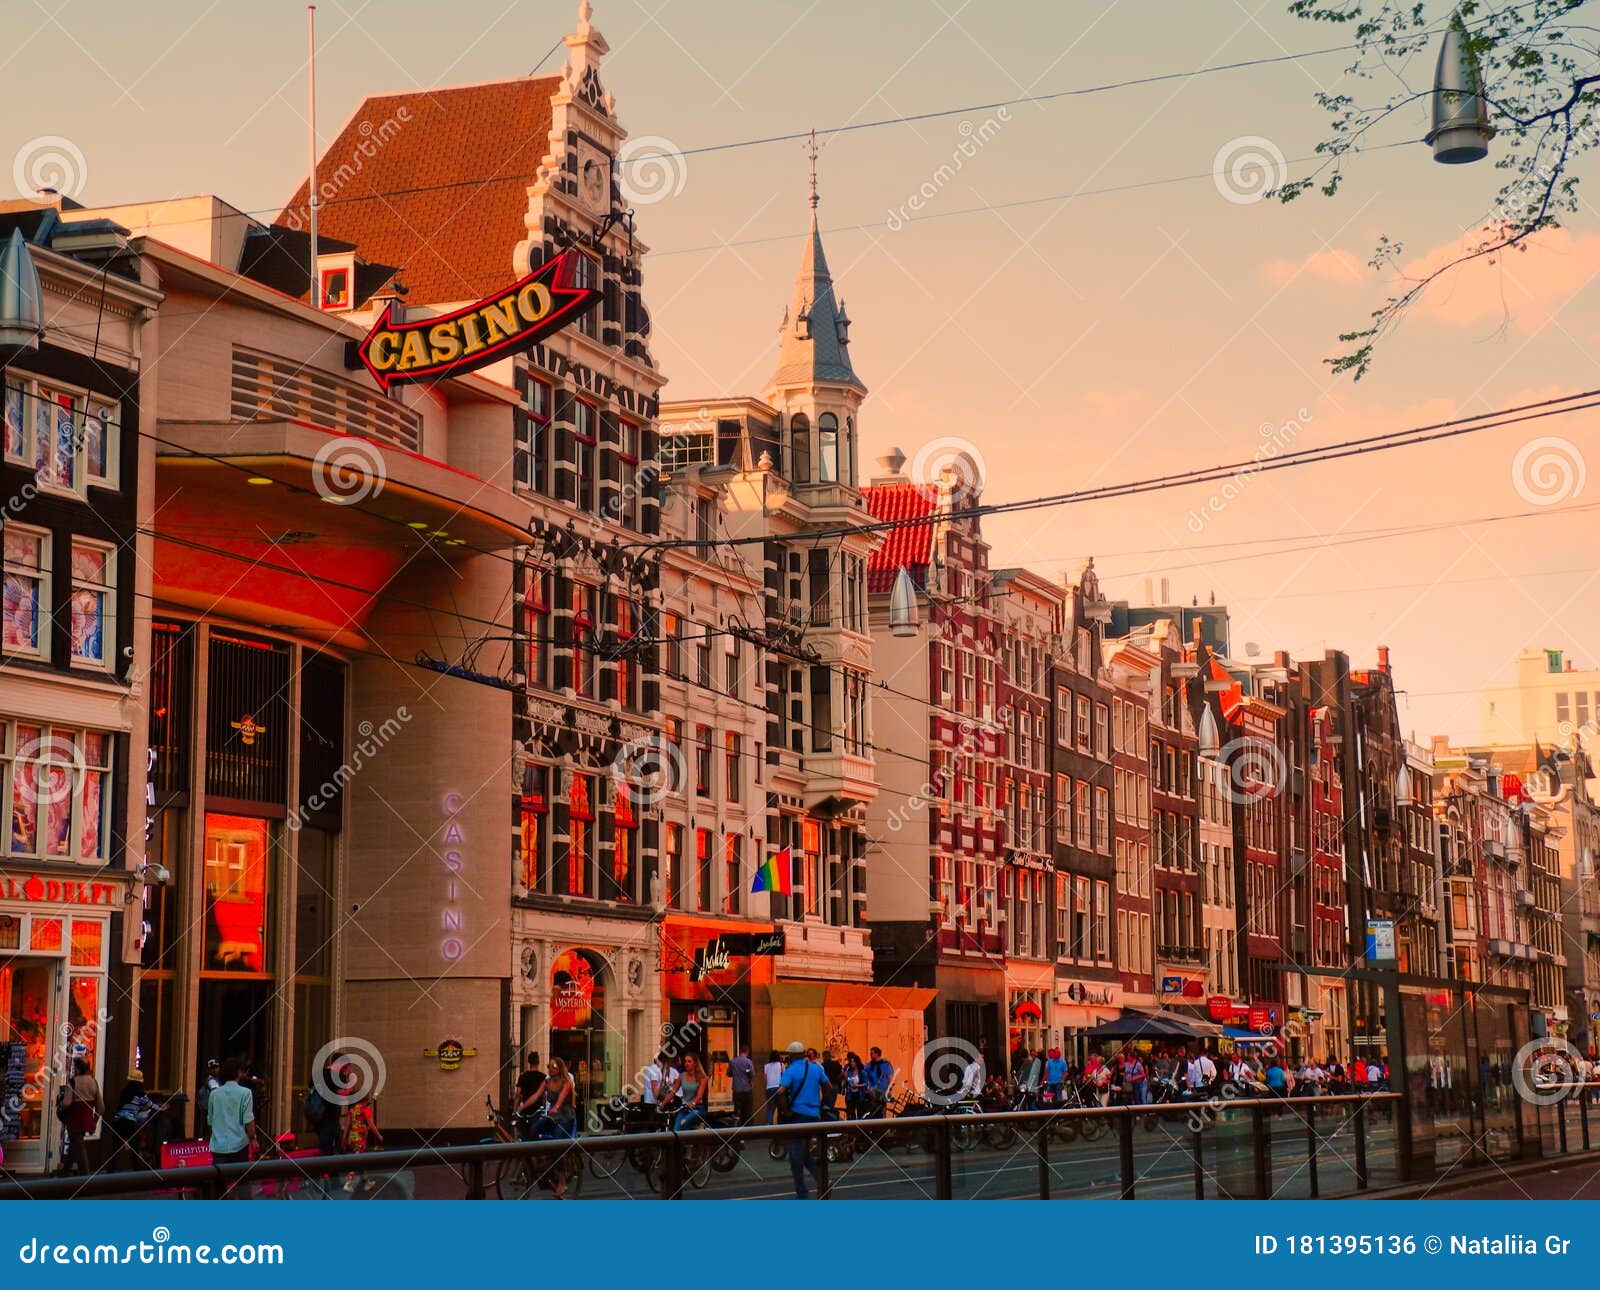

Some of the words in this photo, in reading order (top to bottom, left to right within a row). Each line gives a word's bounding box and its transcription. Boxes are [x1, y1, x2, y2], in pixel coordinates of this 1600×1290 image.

[368, 281, 554, 370] CASINO
[47, 880, 117, 905] DELFT
[443, 792, 464, 963] CASINO
